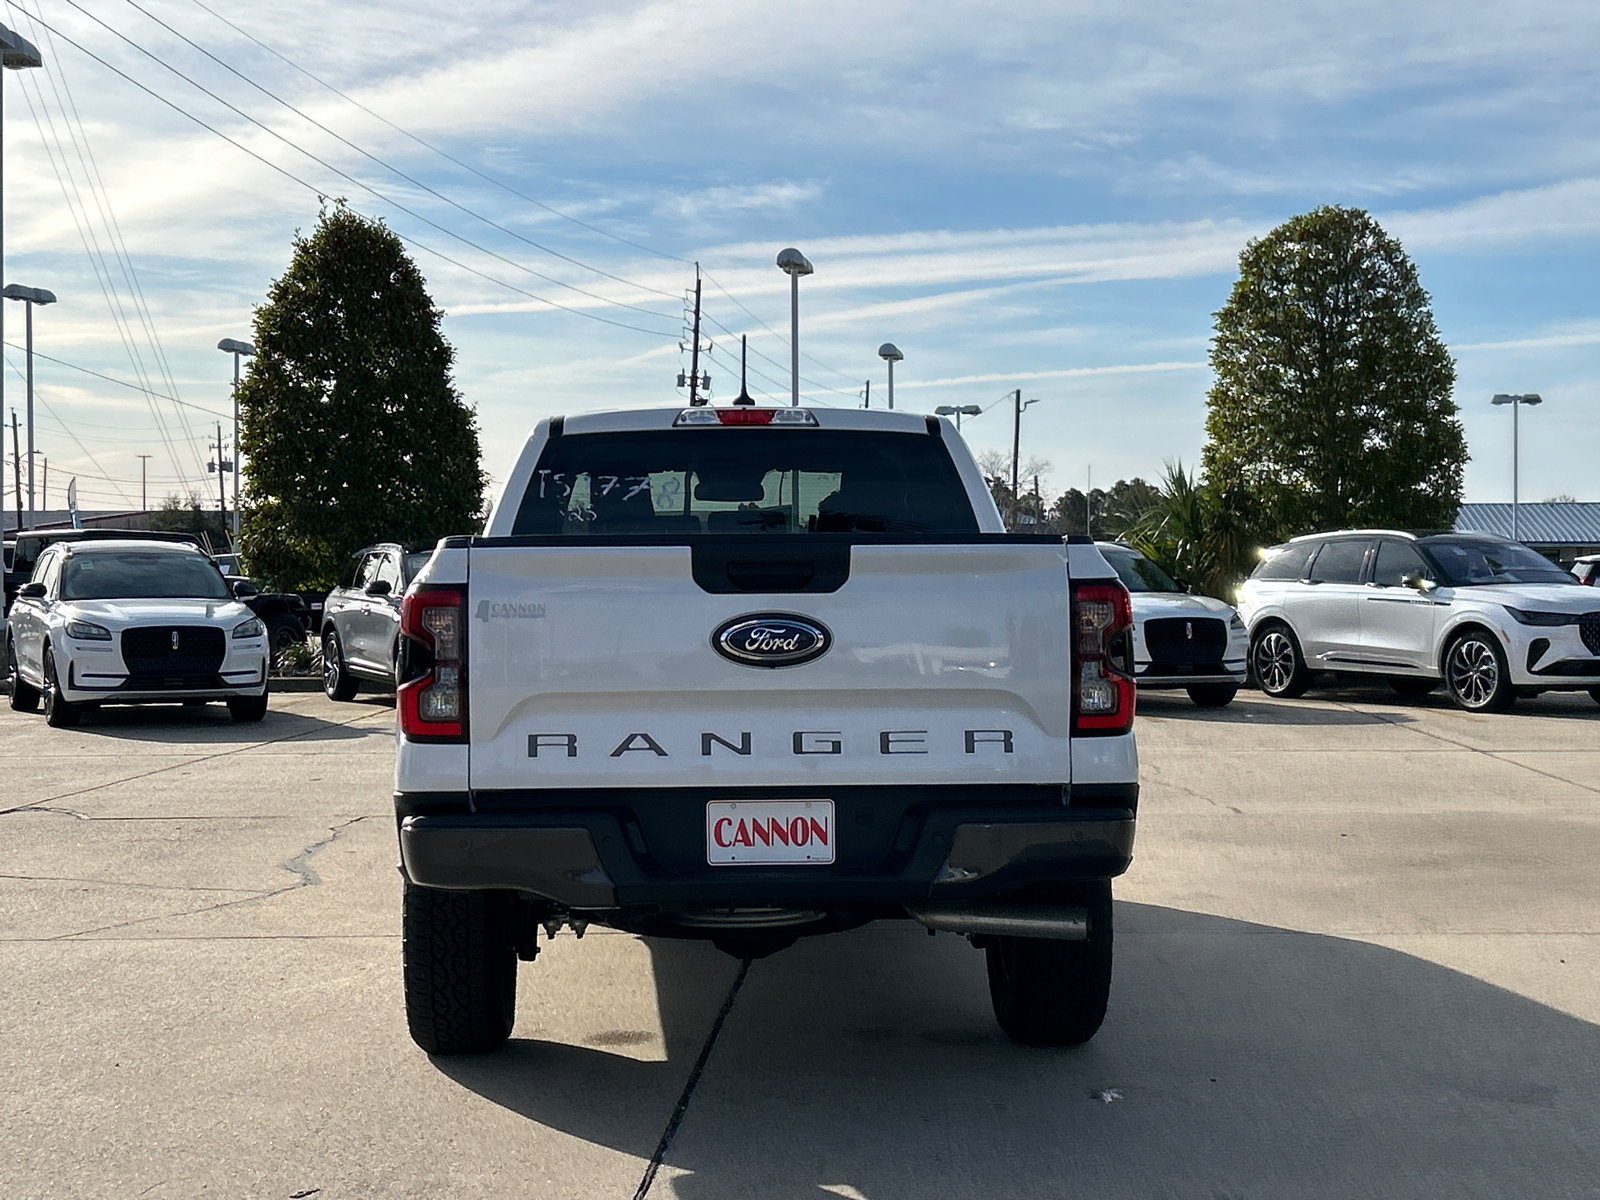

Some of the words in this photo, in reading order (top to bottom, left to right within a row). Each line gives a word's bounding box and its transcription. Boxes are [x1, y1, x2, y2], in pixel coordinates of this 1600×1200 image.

[491, 602, 546, 614] CANNON
[745, 627, 800, 651] Ford
[527, 729, 1014, 758] RANGER
[713, 816, 828, 848] CANNON
